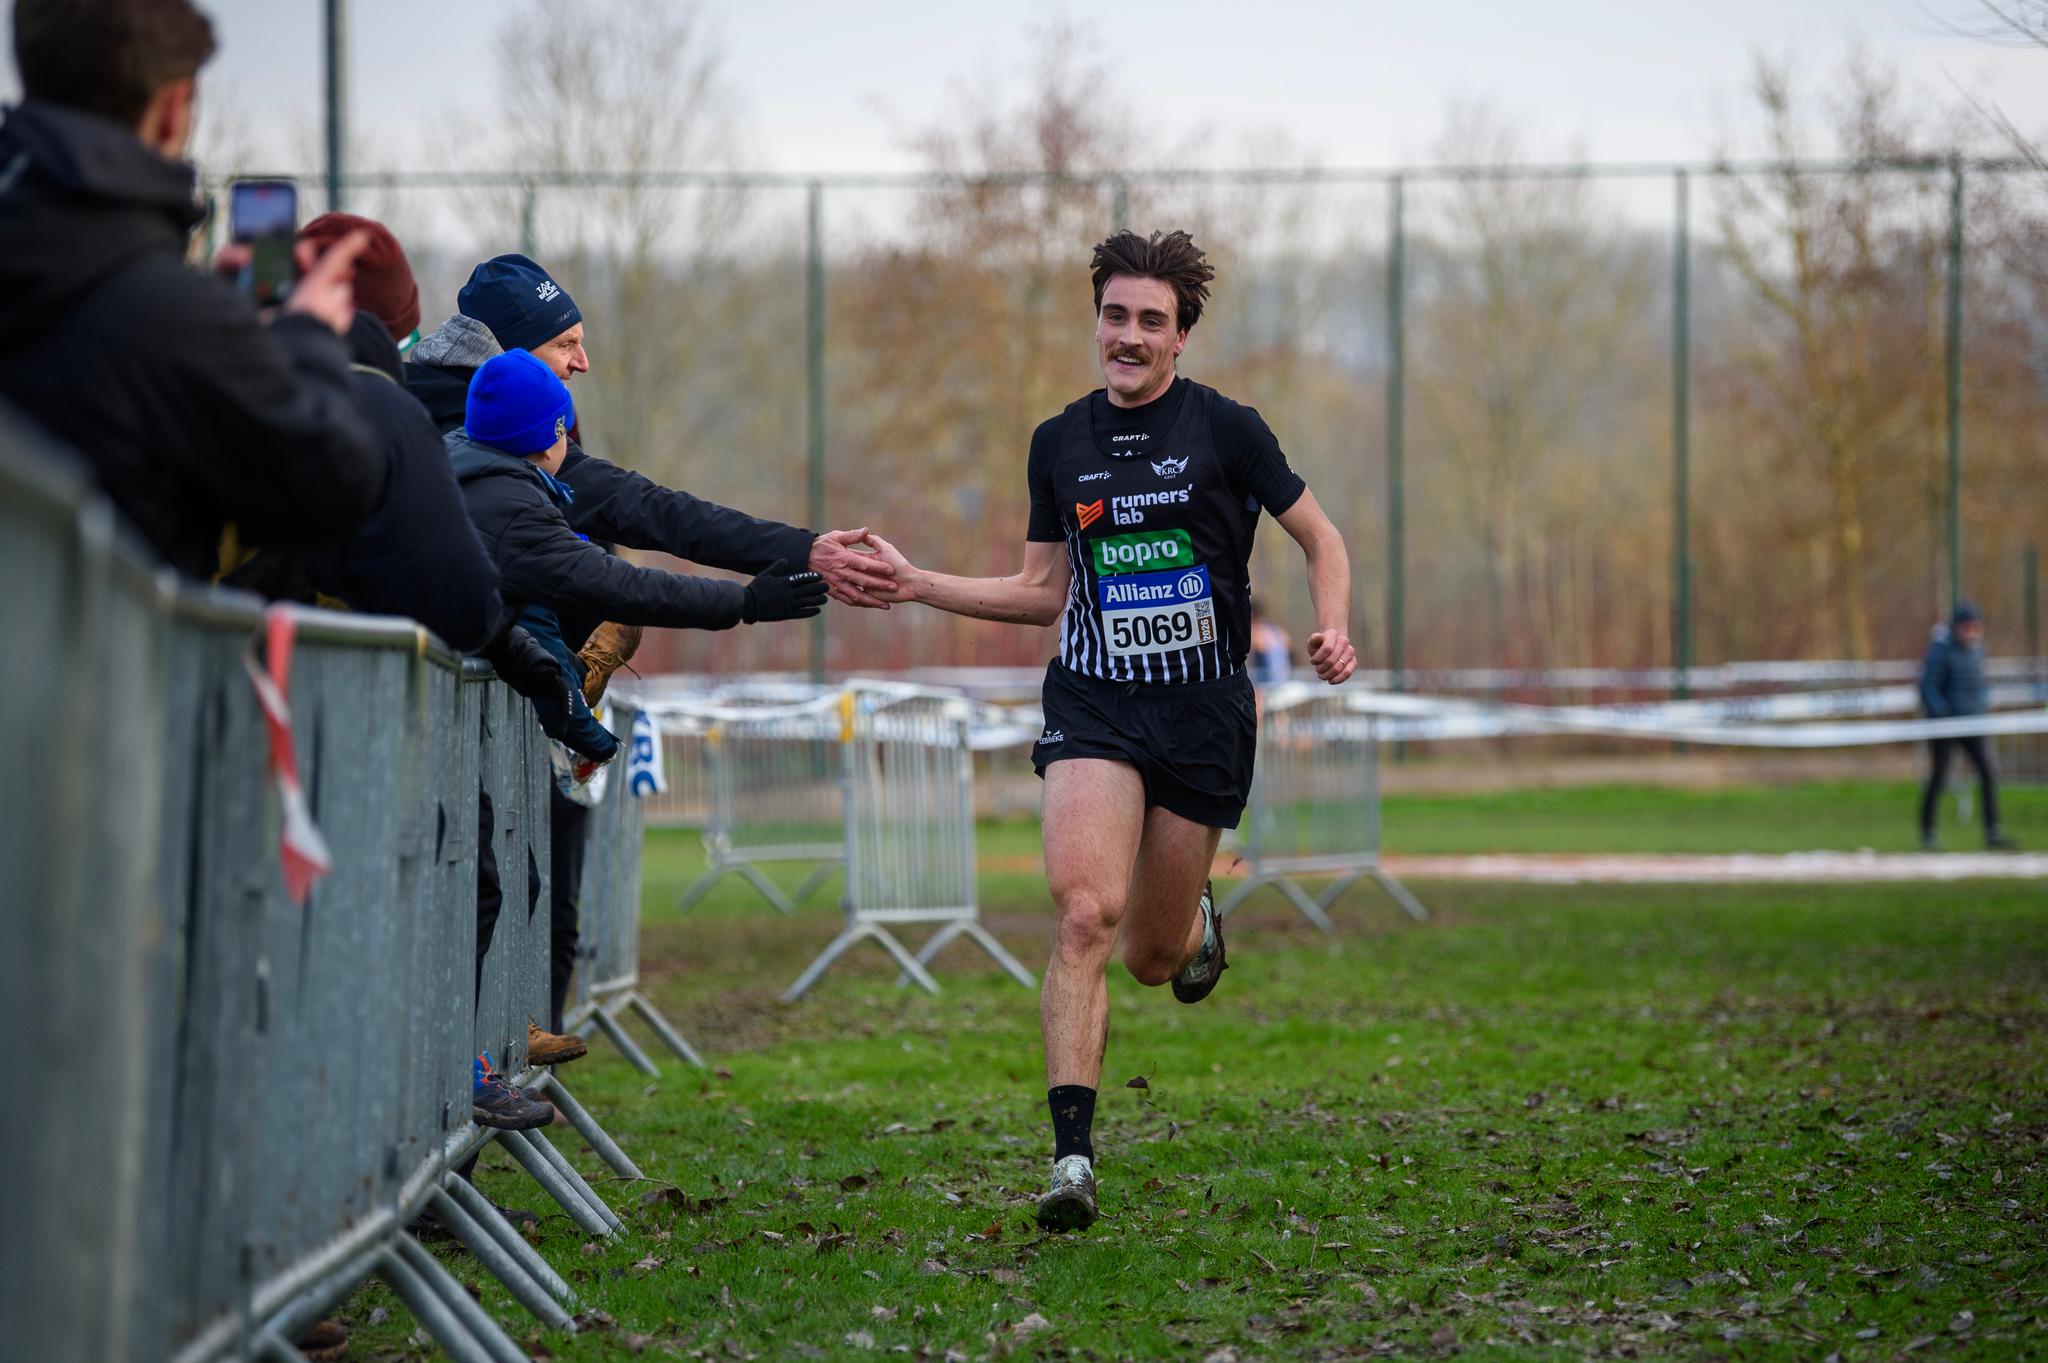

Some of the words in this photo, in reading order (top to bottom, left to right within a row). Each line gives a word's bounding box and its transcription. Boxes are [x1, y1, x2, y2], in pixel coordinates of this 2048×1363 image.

[1112, 434, 1141, 442] CRAFT
[1078, 472, 1105, 482] CRAFT
[1161, 466, 1179, 475] KRC
[1112, 508, 1145, 526] lab
[1101, 540, 1179, 566] bopro
[789, 572, 819, 582] KIPSTA
[1106, 583, 1174, 603] Allianz
[1112, 612, 1192, 648] 5069
[1200, 619, 1212, 640] 2026
